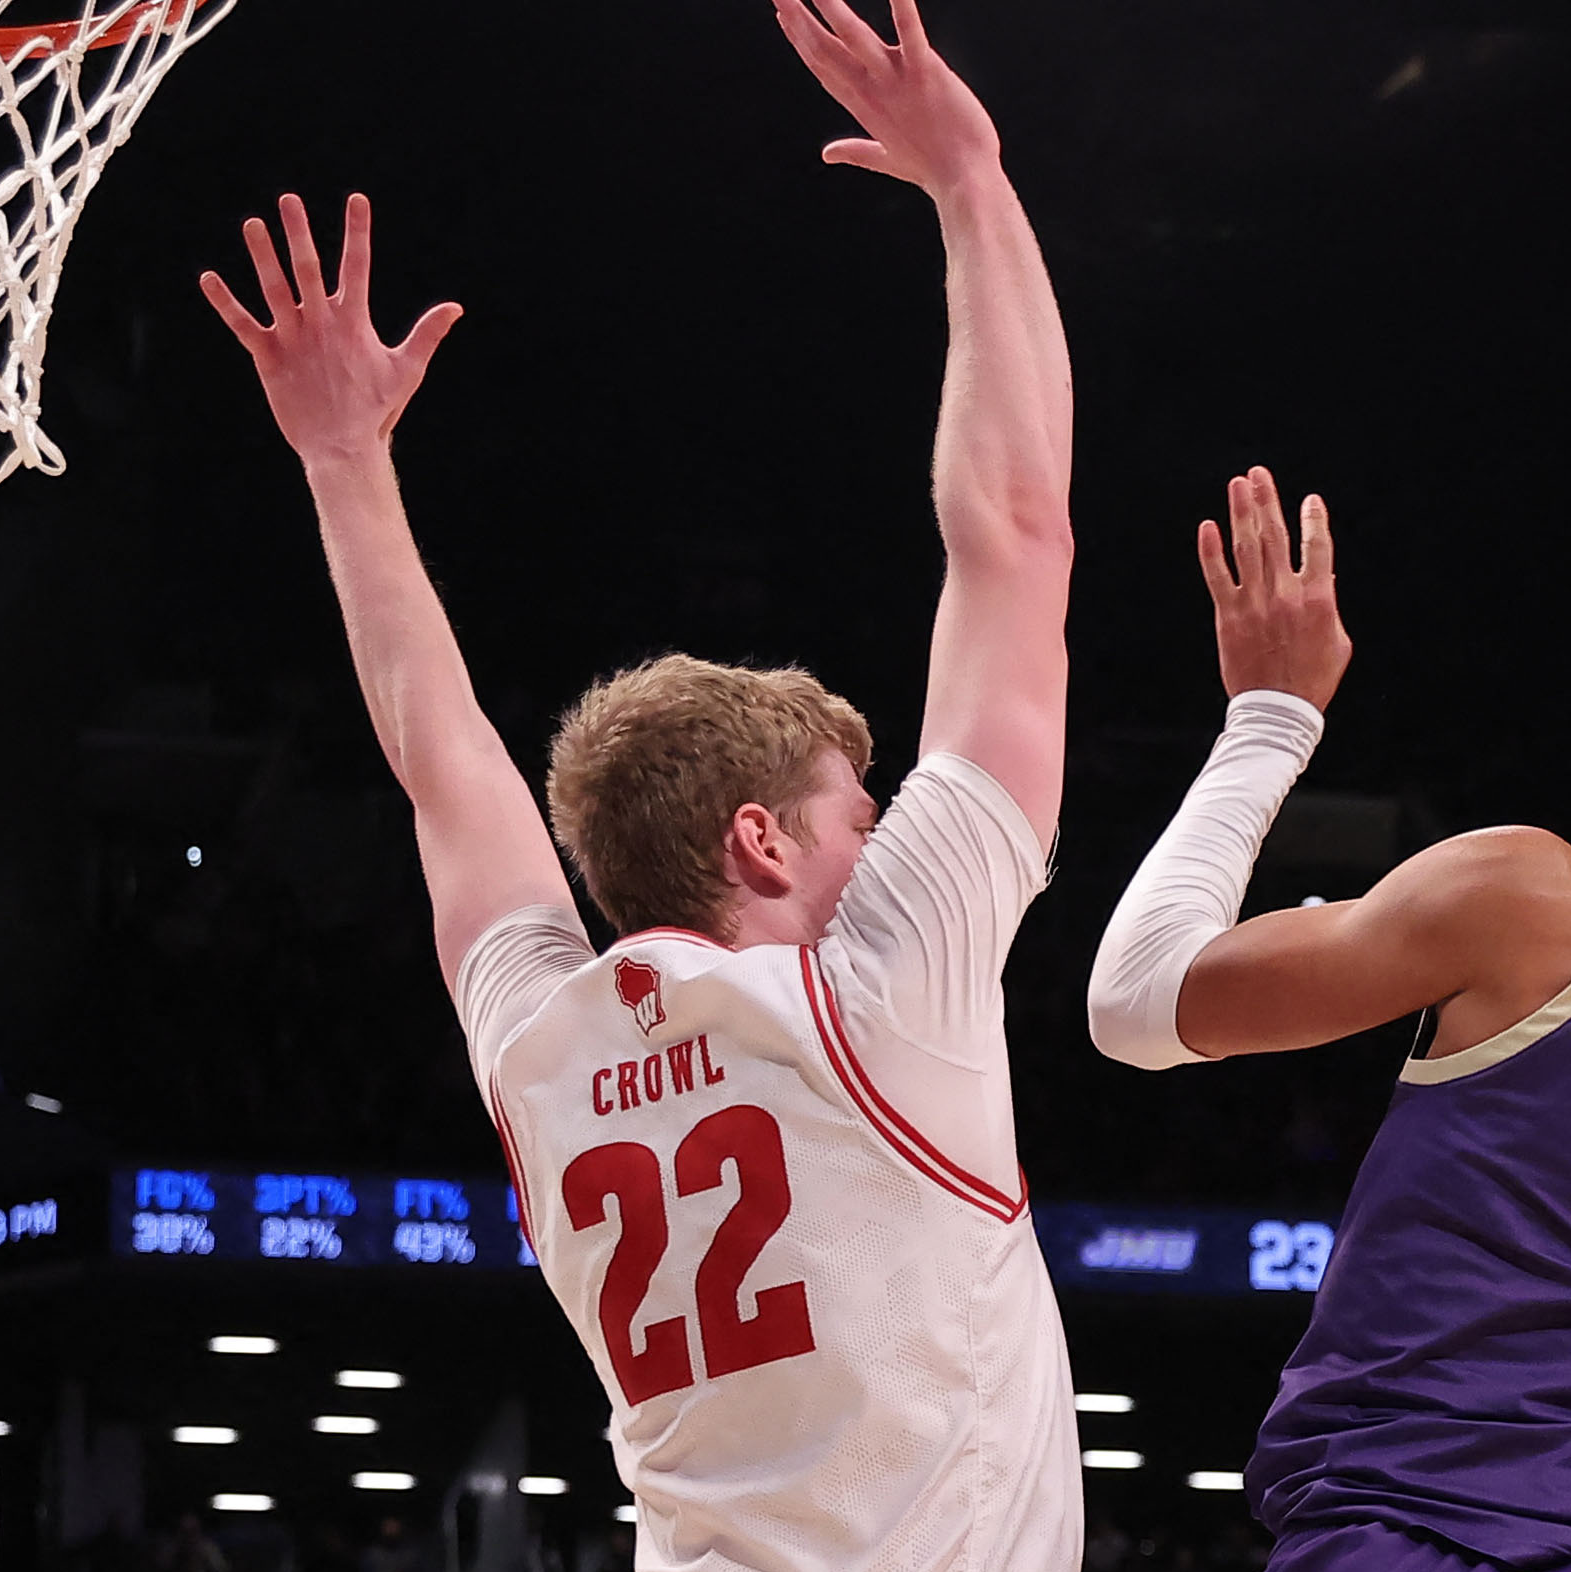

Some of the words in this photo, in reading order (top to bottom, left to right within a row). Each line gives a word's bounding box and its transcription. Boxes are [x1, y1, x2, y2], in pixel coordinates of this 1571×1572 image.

[593, 1033, 725, 1116] CROWL
[9, 1197, 57, 1243] PM
[394, 1178, 470, 1221] FT%
[562, 1104, 817, 1407] 22
[1247, 1219, 1335, 1292] 23
